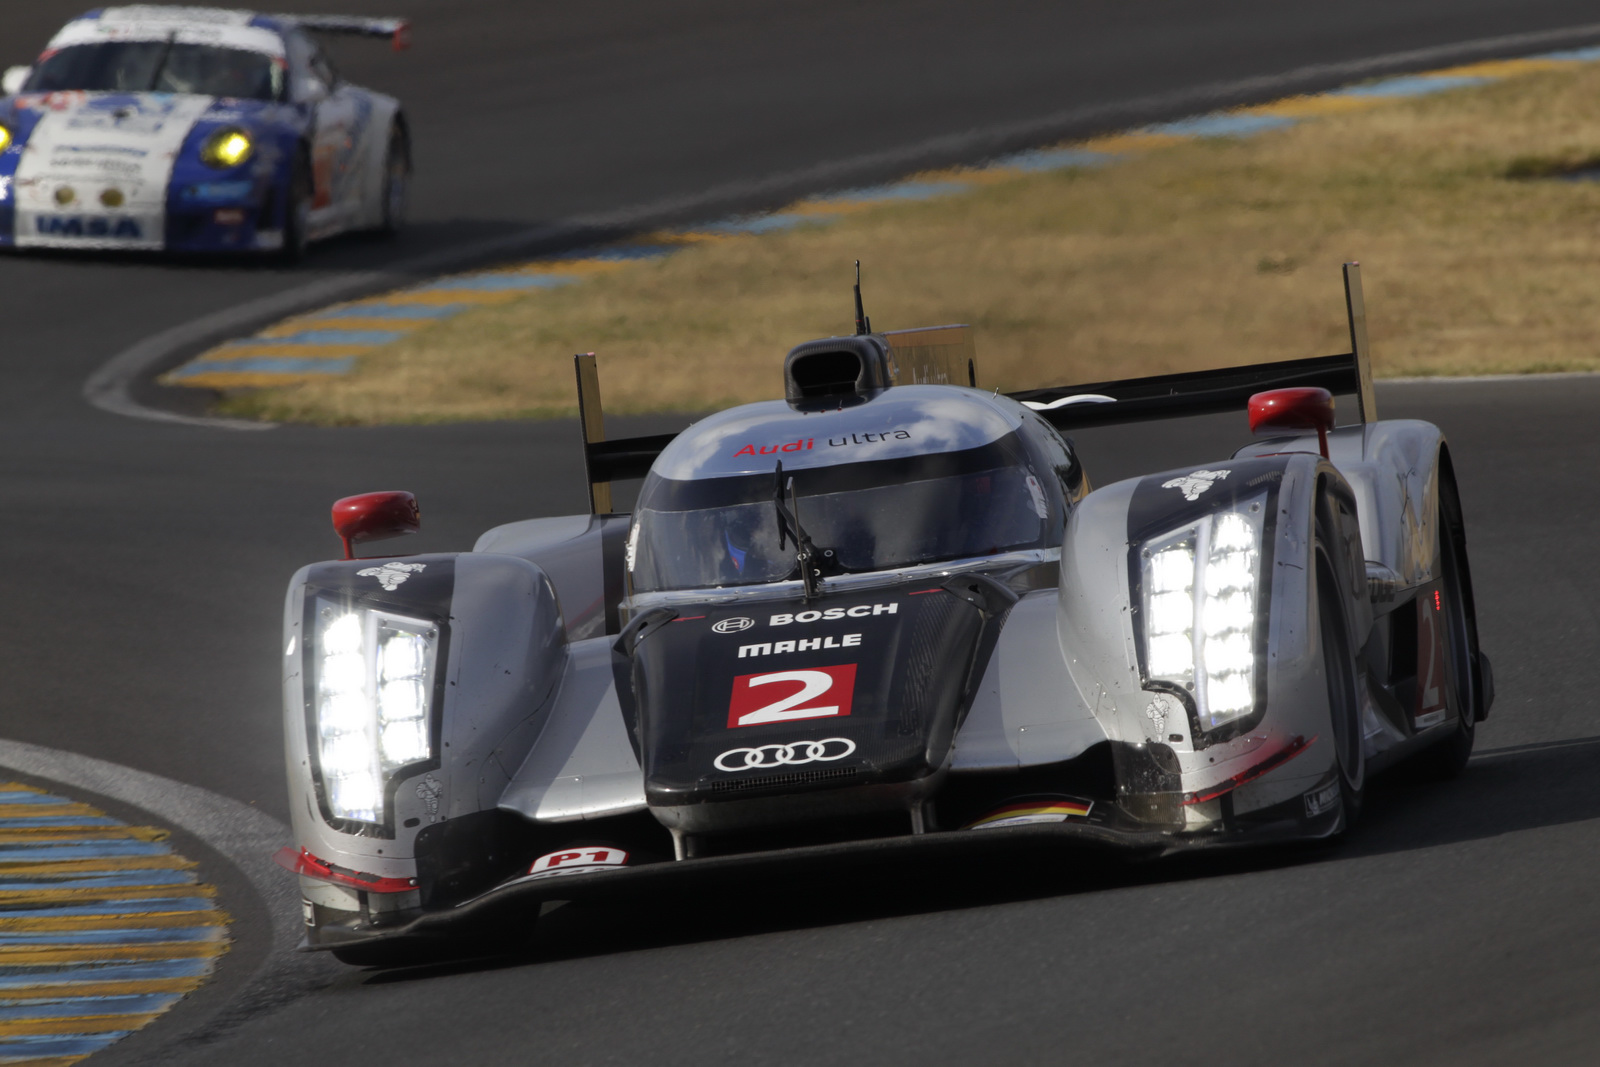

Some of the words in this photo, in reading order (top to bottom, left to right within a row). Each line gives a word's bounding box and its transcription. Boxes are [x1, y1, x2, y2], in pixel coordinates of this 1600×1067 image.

[36, 215, 141, 238] IMSA
[732, 438, 815, 458] Audi
[828, 429, 911, 448] ultra
[769, 602, 899, 627] BOSCH
[737, 633, 863, 659] MAHLE
[1421, 597, 1441, 710] 2
[737, 669, 840, 727] 2
[547, 850, 610, 868] P1
